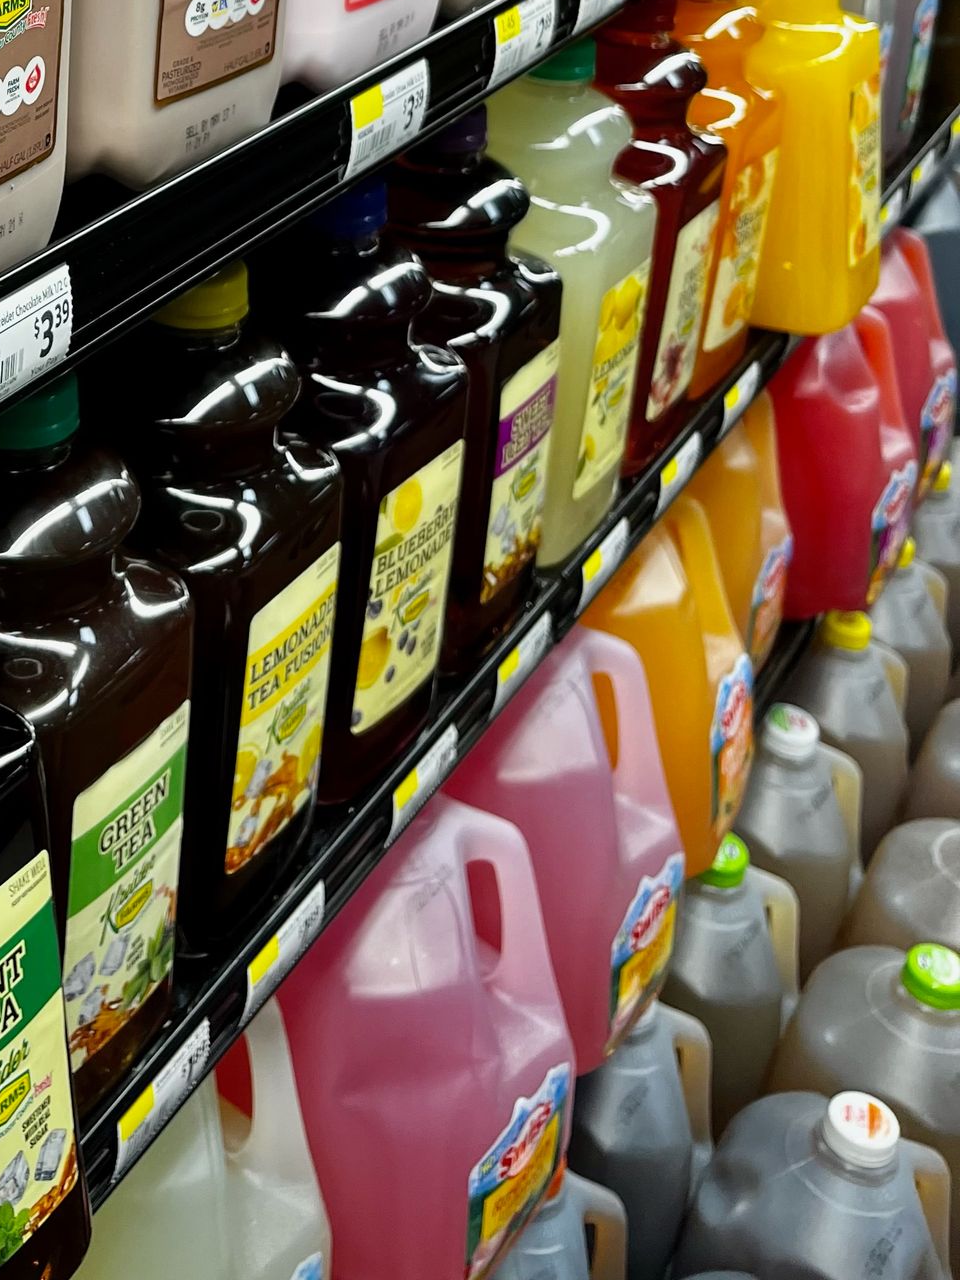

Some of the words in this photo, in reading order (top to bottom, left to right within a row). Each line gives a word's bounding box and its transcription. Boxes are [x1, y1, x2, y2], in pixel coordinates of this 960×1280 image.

[195, 1, 206, 13] 8g
[6, 84, 21, 97] FRESH
[7, 76, 21, 90] FARM
[15, 292, 42, 317] Chocolate
[41, 282, 54, 302] Milk
[54, 278, 64, 293] 1/2
[374, 522, 452, 598] LEMONADE
[376, 500, 457, 576] BLUEBERRY
[247, 673, 280, 711] TEA
[284, 625, 331, 682] FUSION
[250, 592, 337, 685] LEMONADE
[100, 772, 169, 854] GREEN
[113, 821, 154, 869] TEA
[499, 1098, 553, 1181] Swiss
